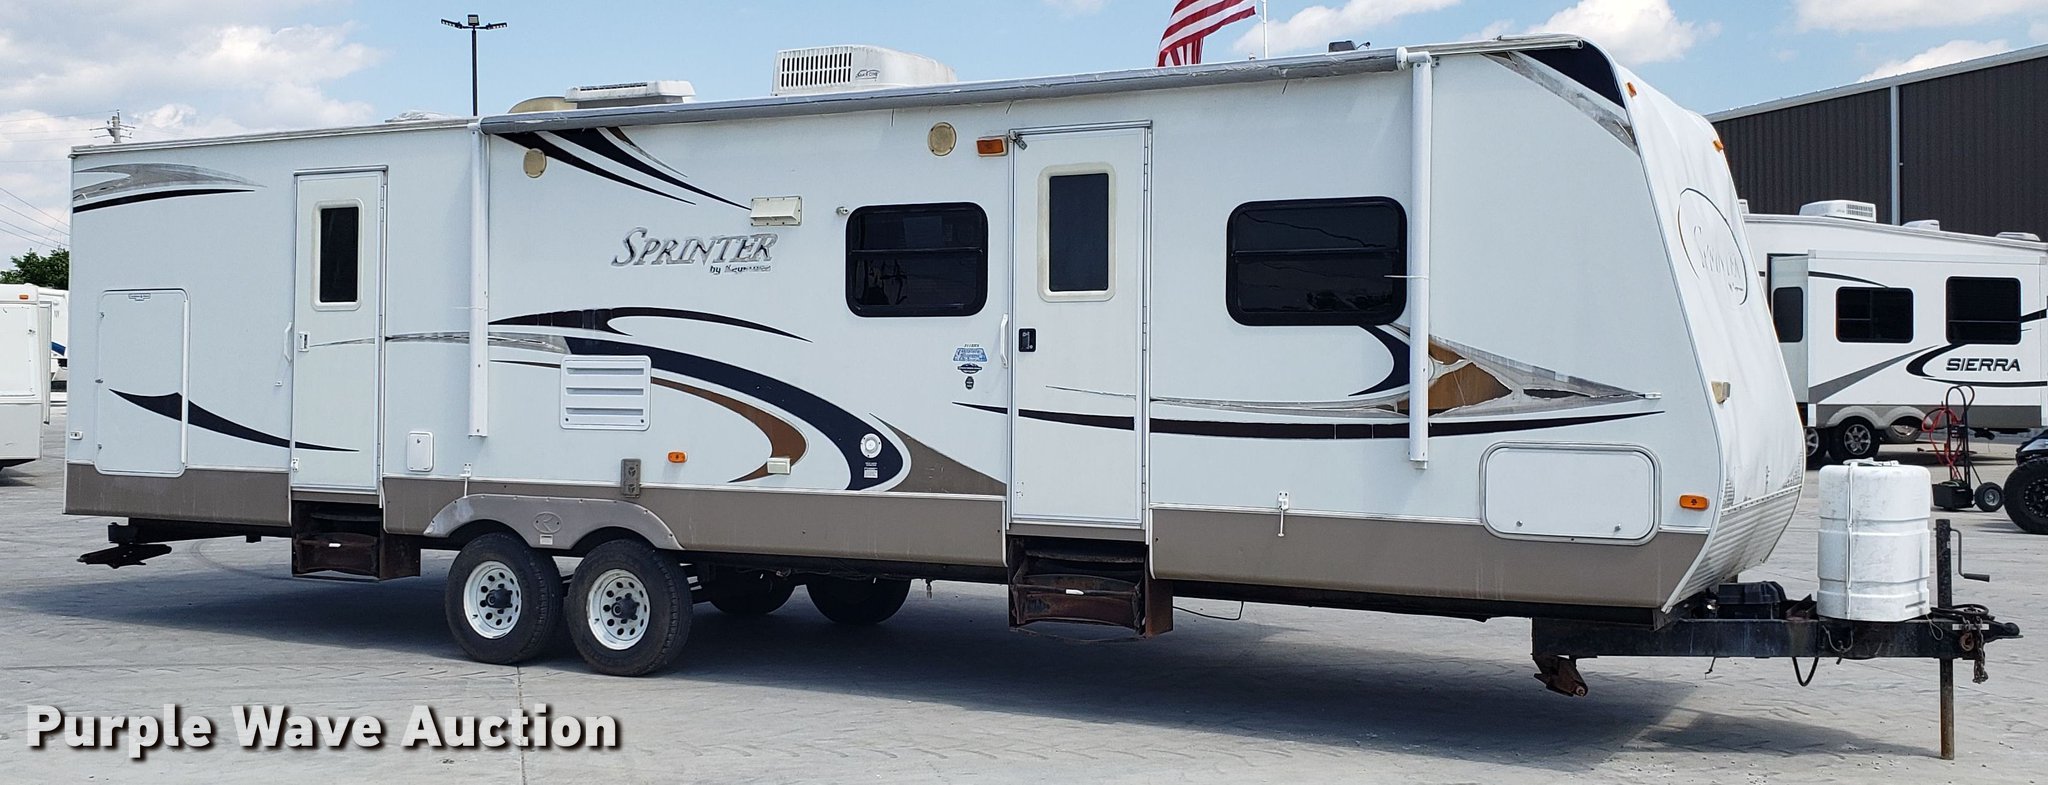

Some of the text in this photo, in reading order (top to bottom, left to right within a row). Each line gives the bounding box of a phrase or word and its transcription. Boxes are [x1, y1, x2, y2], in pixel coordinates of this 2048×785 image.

[611, 227, 778, 266] SPRINTER
[710, 265, 721, 275] by
[1946, 358, 2020, 371] SIERRA
